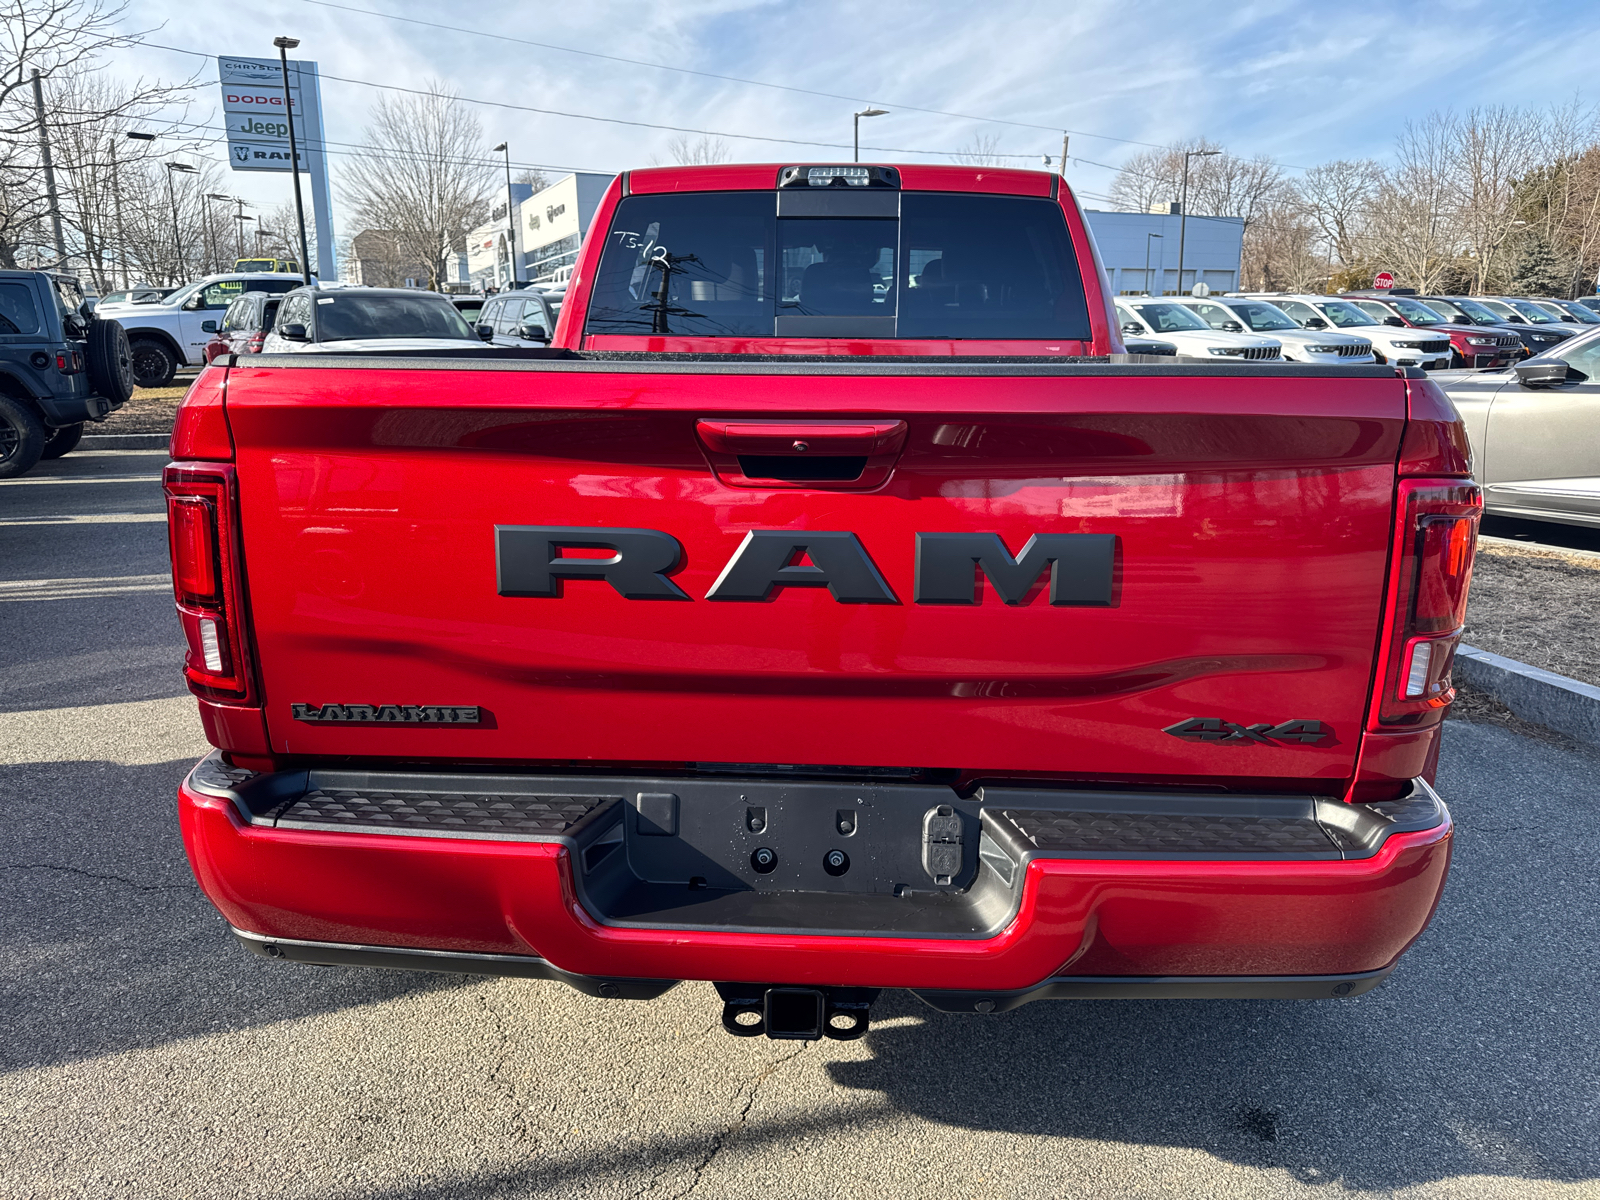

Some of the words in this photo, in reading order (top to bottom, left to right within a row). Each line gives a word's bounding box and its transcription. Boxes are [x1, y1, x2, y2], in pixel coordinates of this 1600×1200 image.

[225, 63, 290, 72] CHRYSLE
[227, 95, 296, 106] DODGE
[241, 118, 288, 137] Jeep
[253, 151, 301, 161] RAM
[1375, 278, 1393, 288] STOP
[494, 524, 1116, 607] RAM
[291, 703, 480, 723] LARAMIE
[1161, 717, 1327, 742] 4x4
